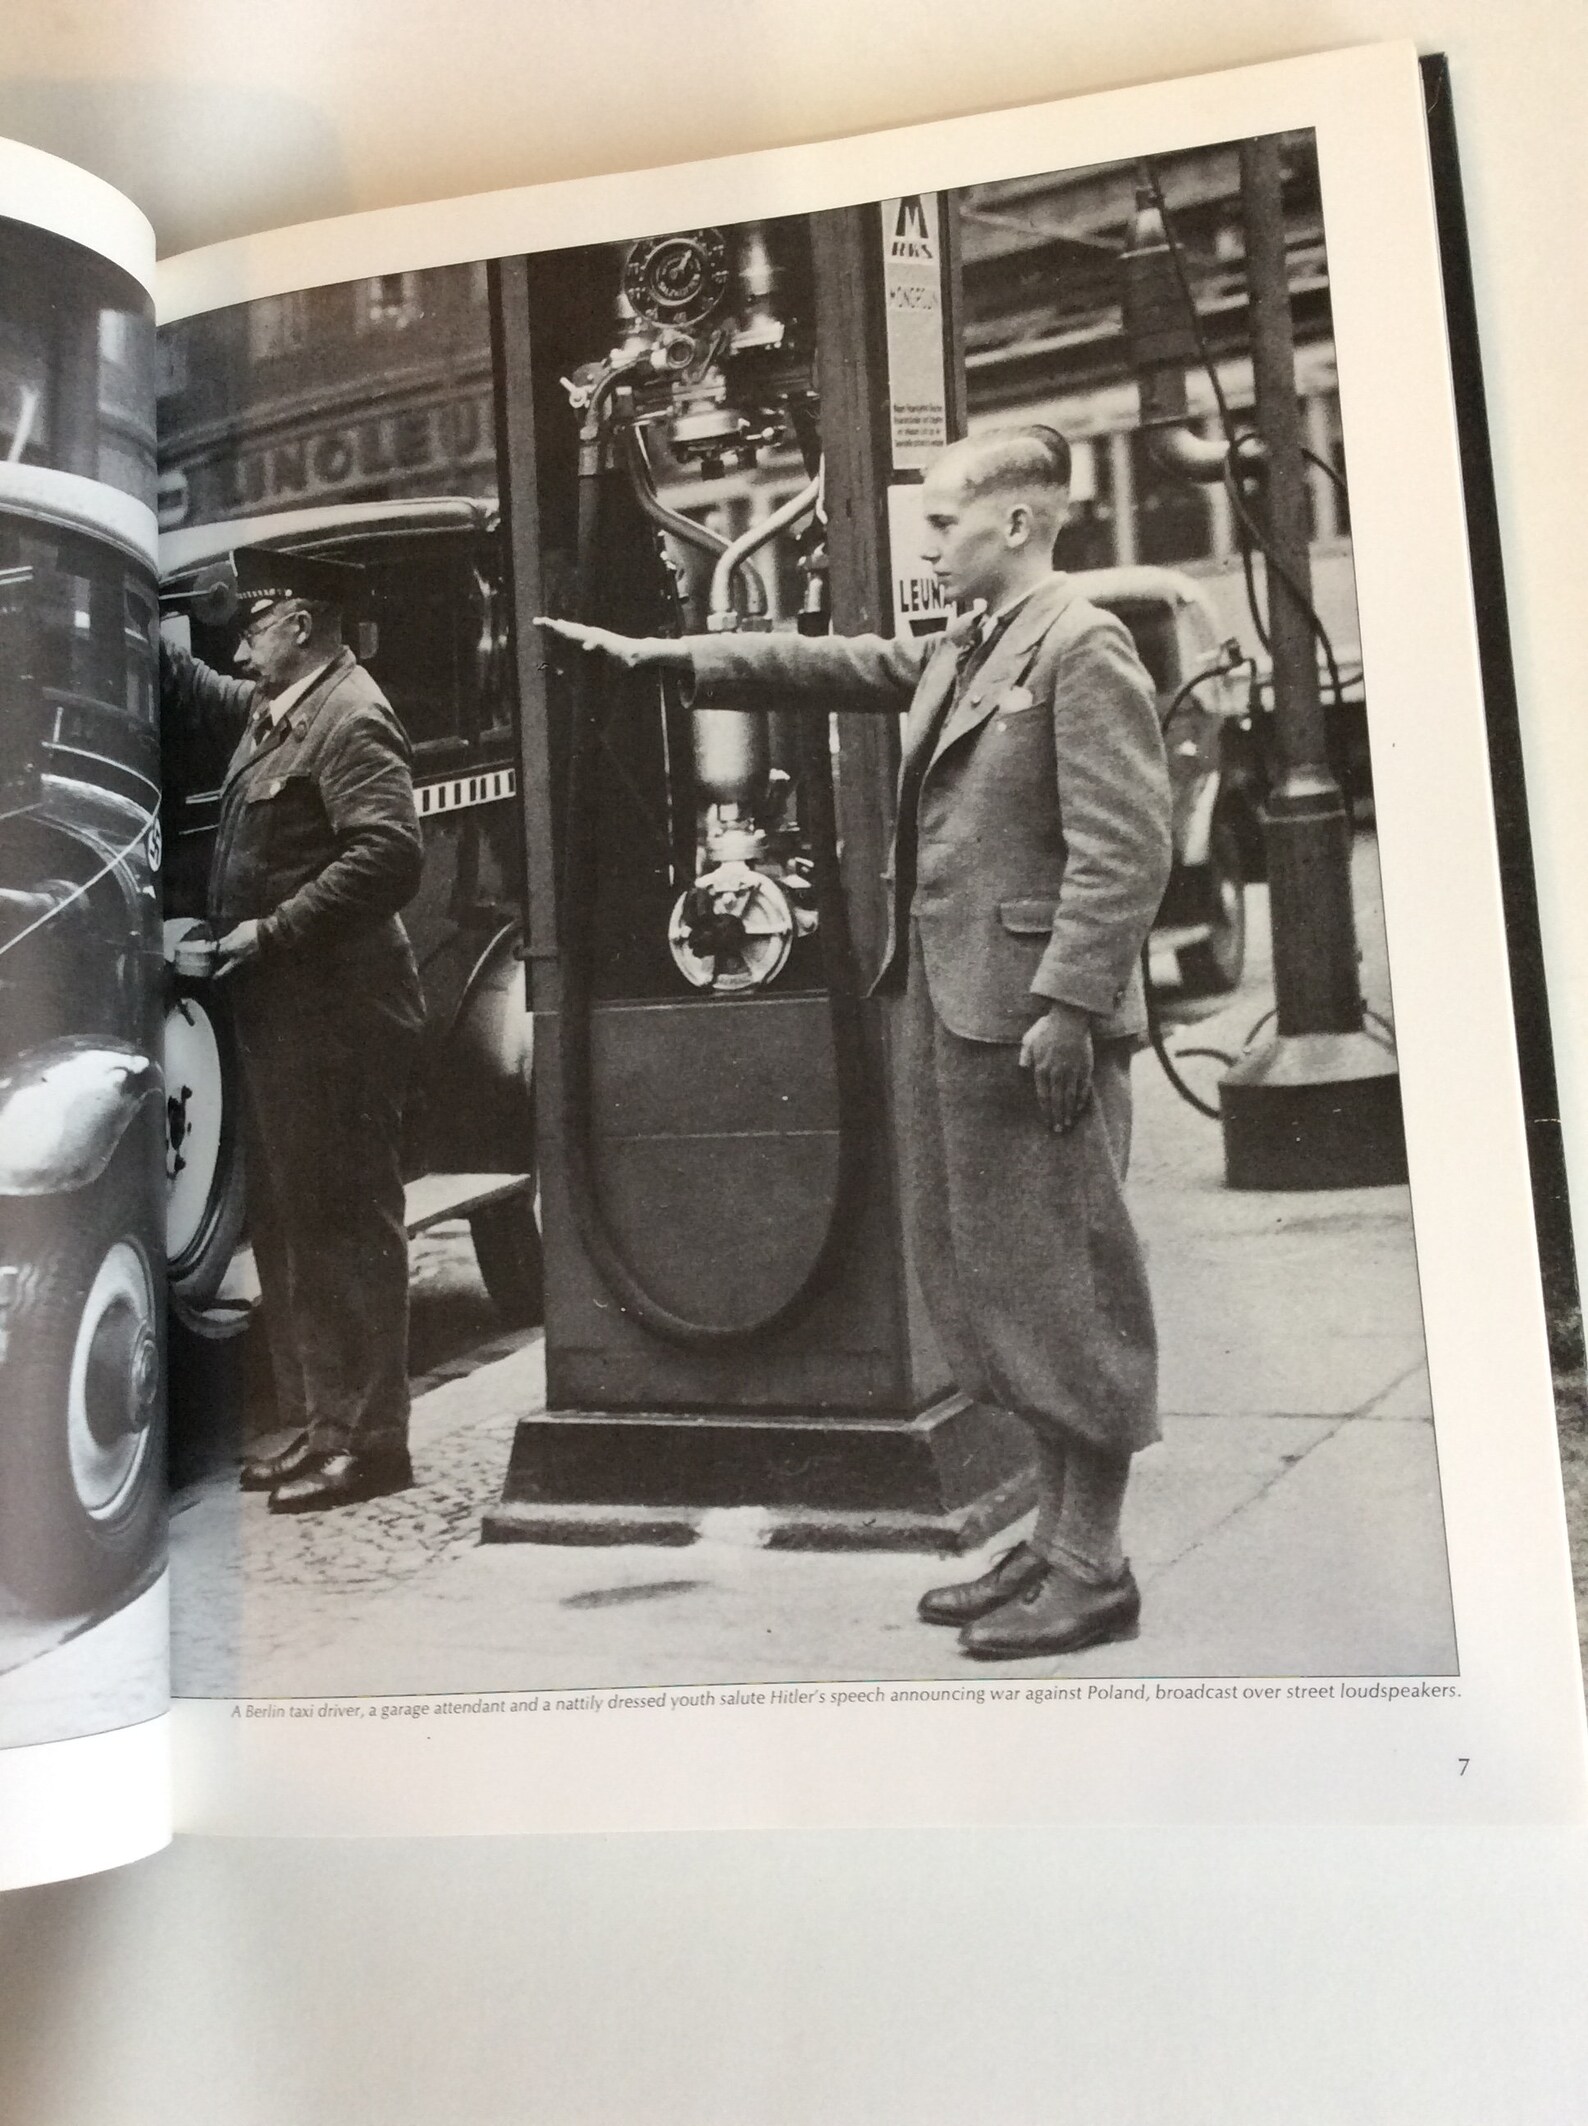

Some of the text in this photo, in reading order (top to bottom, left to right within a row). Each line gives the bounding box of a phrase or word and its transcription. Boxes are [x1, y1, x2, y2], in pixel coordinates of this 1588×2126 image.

[900, 578, 946, 612] LEUN
[231, 1704, 241, 1718] A
[246, 1703, 285, 1718] Berlin
[289, 1703, 314, 1718] taxi
[318, 1702, 364, 1718] driver,
[369, 1707, 377, 1716] a
[381, 1705, 430, 1719] garage
[434, 1698, 505, 1714] attendant
[510, 1697, 538, 1712] and
[542, 1701, 551, 1711] a
[556, 1694, 603, 1713] nattily
[608, 1692, 666, 1709] dressed
[671, 1691, 715, 1710] youth
[720, 1689, 765, 1705] salute
[830, 1687, 885, 1706] speech
[890, 1686, 985, 1704] announcing
[990, 1690, 1020, 1700] war
[1026, 1686, 1081, 1704] against
[1088, 1684, 1150, 1702] Poland,
[1156, 1683, 1238, 1700] broadcast
[1243, 1687, 1281, 1699] over
[1287, 1685, 1335, 1698] street
[1341, 1682, 1461, 1702] loudspeakers.
[1458, 1758, 1470, 1776] 7
